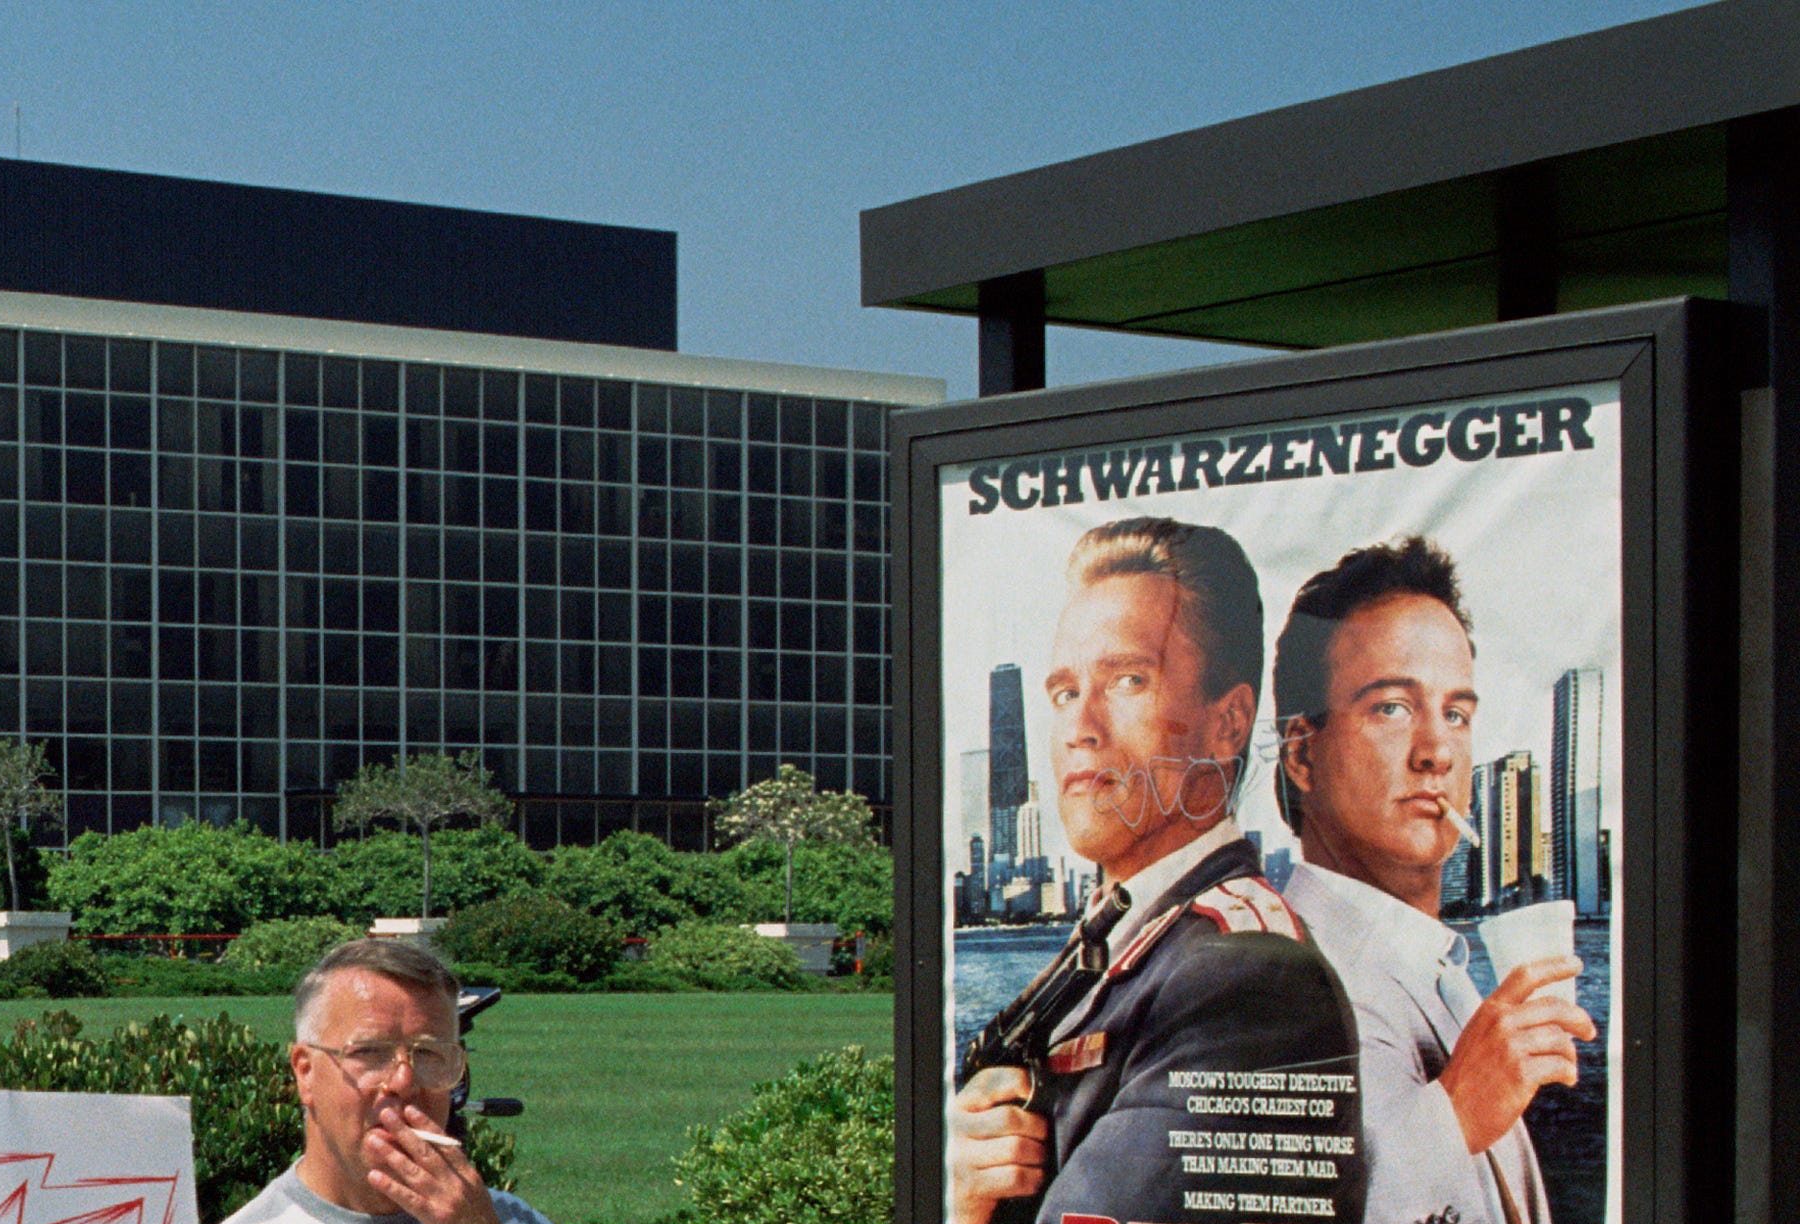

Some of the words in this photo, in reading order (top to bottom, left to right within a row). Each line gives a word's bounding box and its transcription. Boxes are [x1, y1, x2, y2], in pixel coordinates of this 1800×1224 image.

[969, 396, 1594, 516] SCHWARZENEGGER
[1168, 1071, 1225, 1089] MOSCOW'S
[1227, 1073, 1287, 1091] TOUGHEST
[1289, 1074, 1357, 1093] DETECTIVE.
[1186, 1096, 1250, 1115] CHICAGO'S
[1251, 1098, 1308, 1116] CRAZIEST
[1309, 1099, 1335, 1117] COP.
[1168, 1130, 1212, 1148] THERE'S
[1214, 1132, 1247, 1150] ONLY
[1249, 1133, 1273, 1150] ONE
[1275, 1134, 1312, 1152] THING
[1313, 1136, 1355, 1154] WORSE
[1181, 1155, 1215, 1174] THAN
[1217, 1156, 1269, 1175] MAKING
[1270, 1158, 1305, 1176] THEM
[1306, 1160, 1338, 1179] MAD.
[1184, 1191, 1236, 1211] MAKING
[1237, 1194, 1270, 1213] THEM
[1272, 1195, 1336, 1217] PARTNERS.
